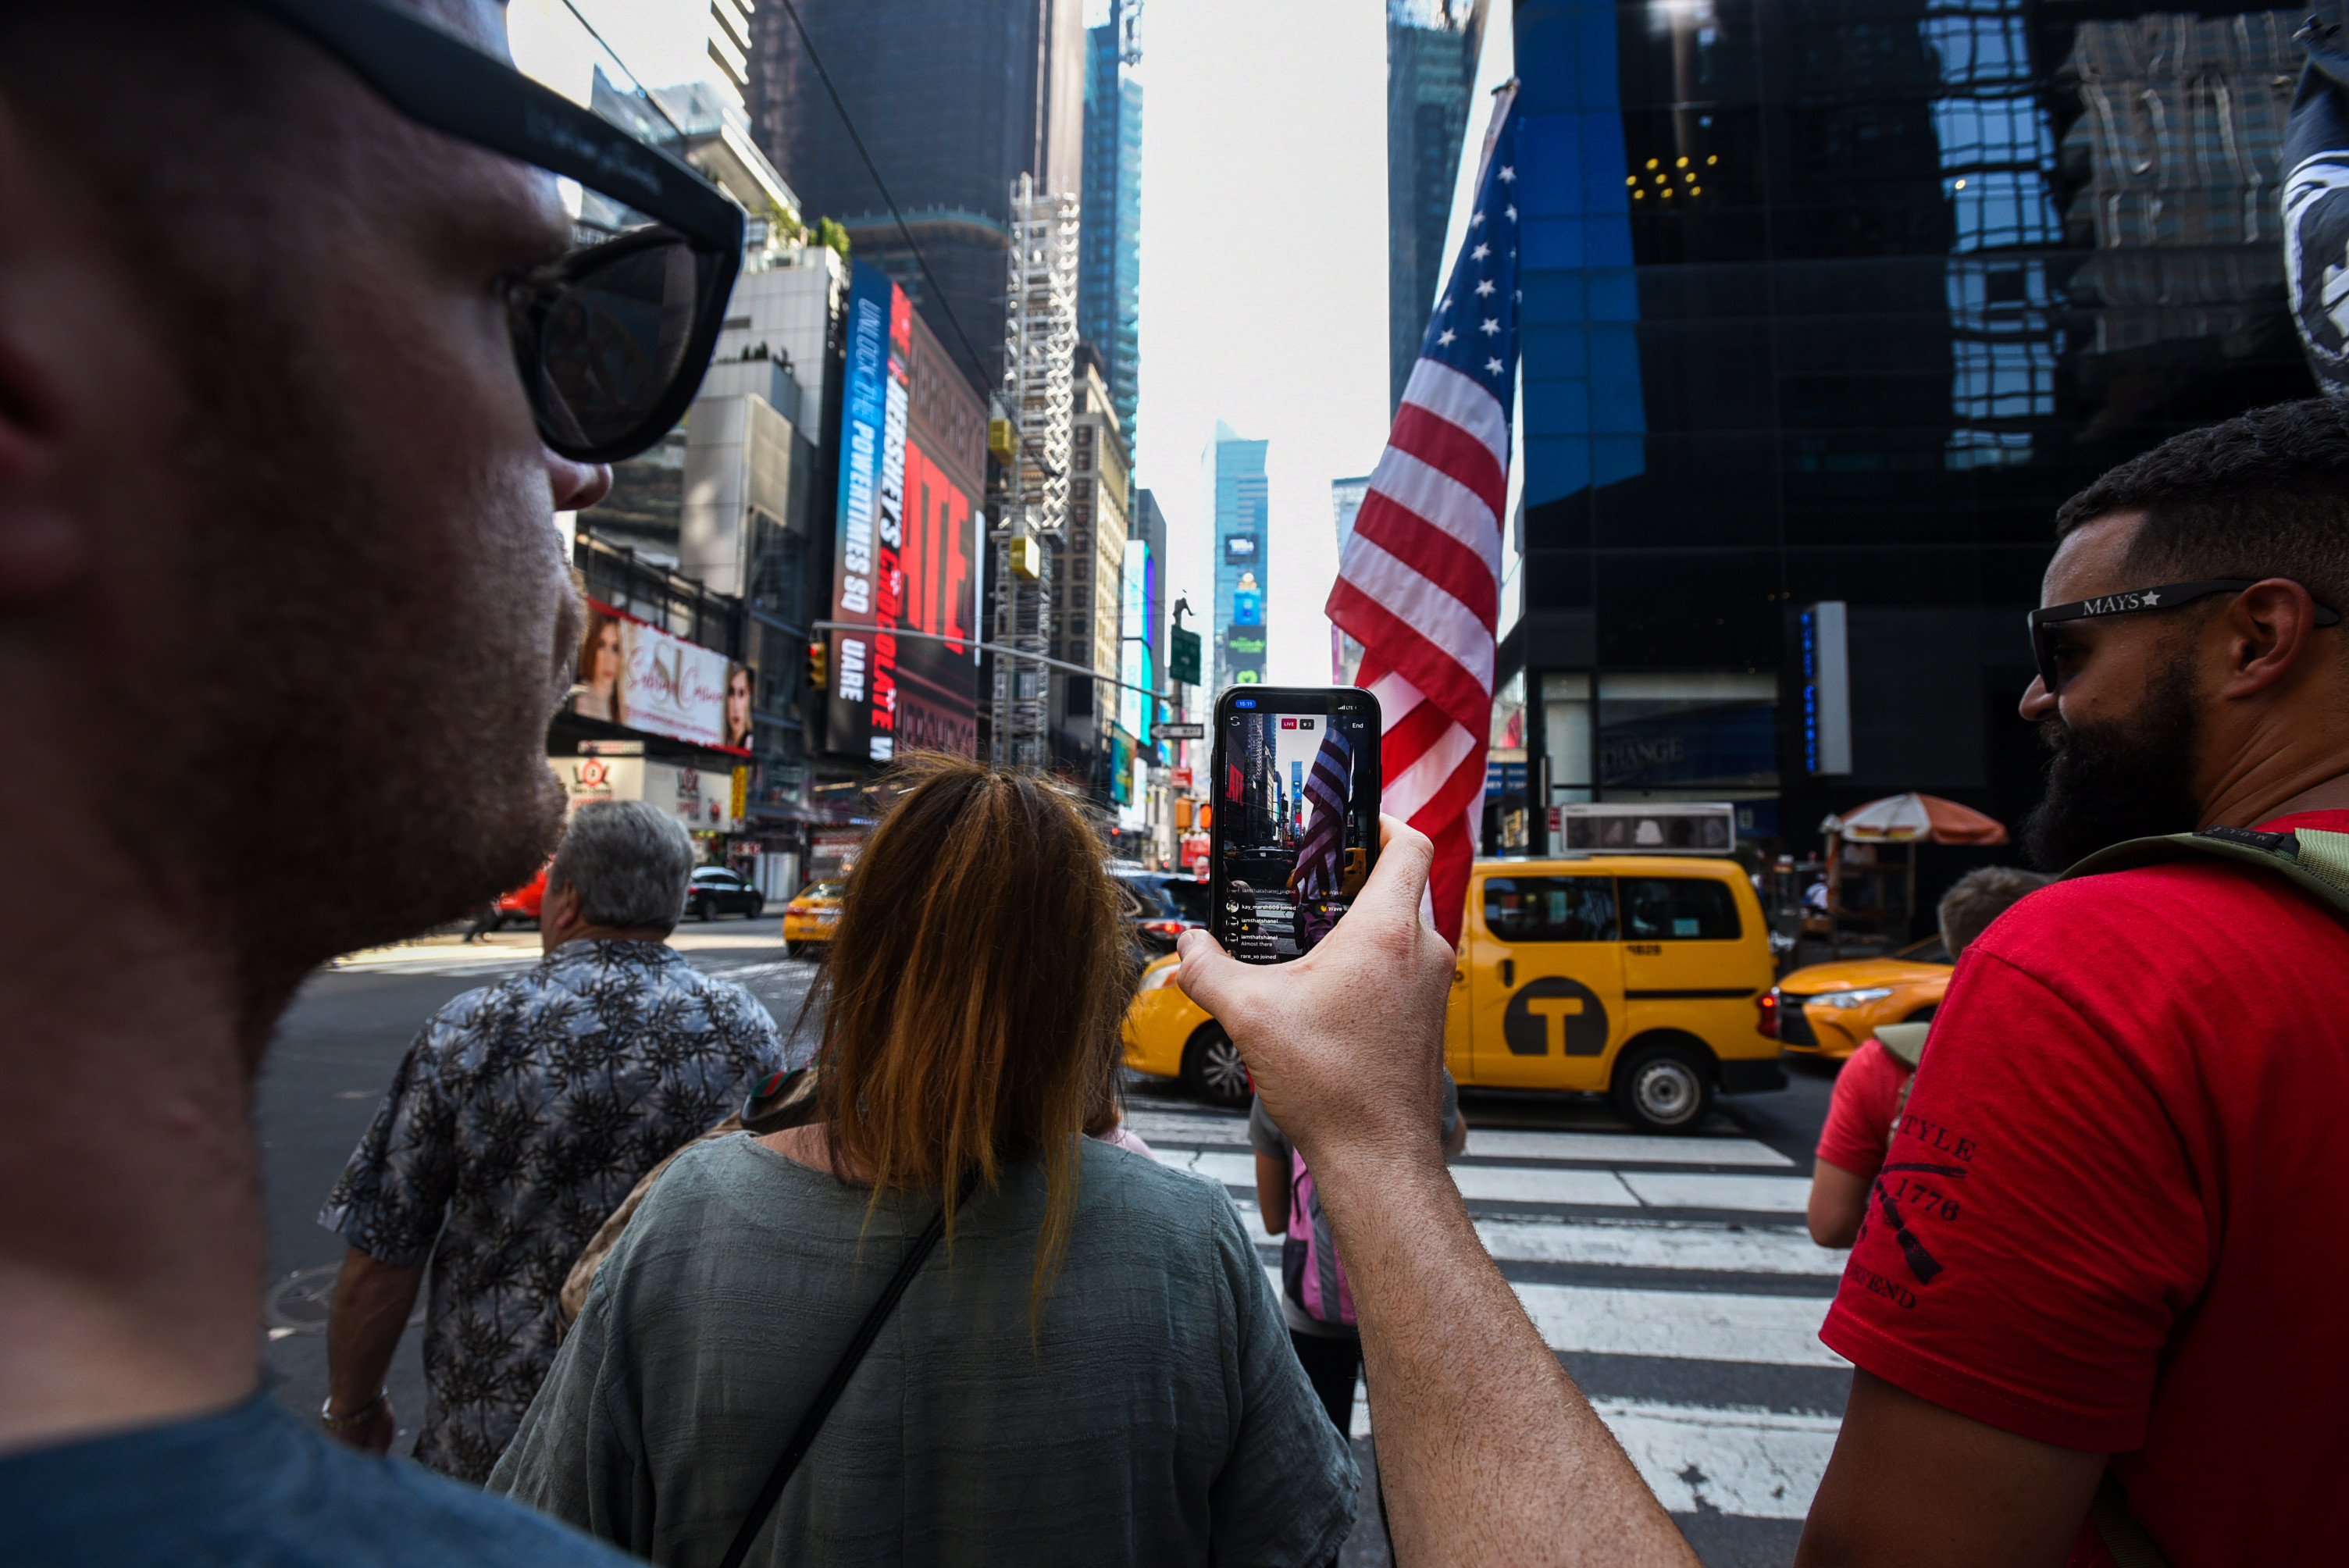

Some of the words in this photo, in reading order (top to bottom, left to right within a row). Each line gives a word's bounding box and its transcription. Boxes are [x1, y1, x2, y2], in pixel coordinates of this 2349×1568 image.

[880, 375, 909, 548] HERSHEY'S
[2083, 593, 2140, 616] MAYS
[872, 547, 900, 731] CHOCOLATE
[1526, 996, 1584, 1057] T
[1895, 1179, 1960, 1222] 1776
